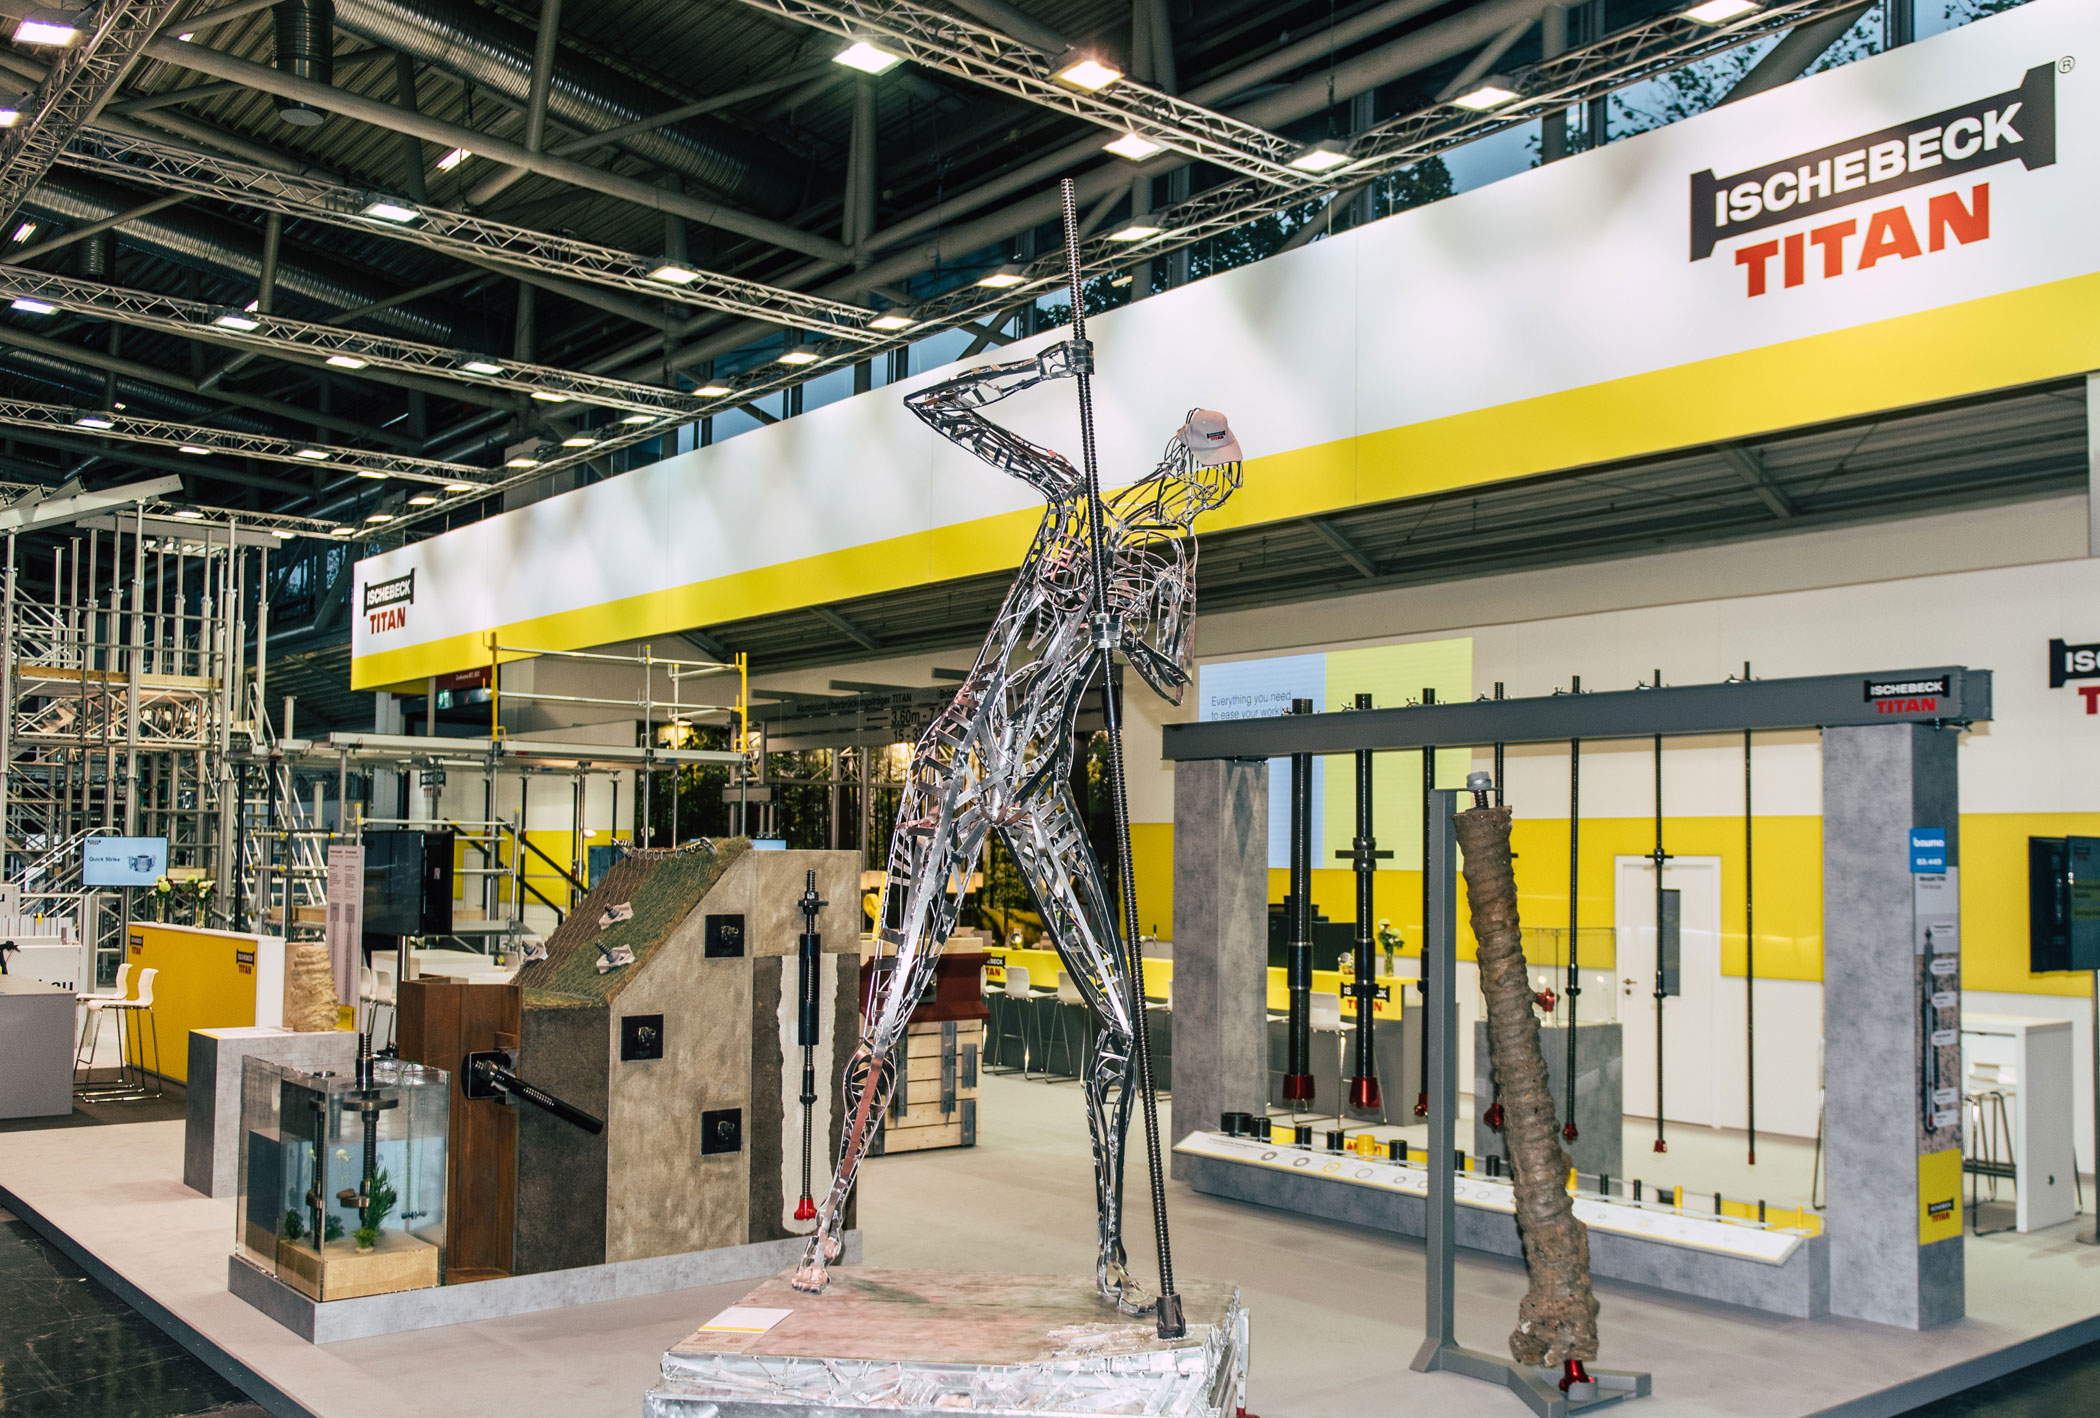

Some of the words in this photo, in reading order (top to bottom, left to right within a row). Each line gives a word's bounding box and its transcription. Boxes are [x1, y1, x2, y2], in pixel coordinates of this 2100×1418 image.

[1715, 102, 2024, 227] ISCHEBECK
[1735, 182, 1990, 298] TITAN
[367, 579, 411, 606] ISCHEBECK
[369, 606, 406, 635] TITAN
[2065, 650, 2100, 673] IS
[1870, 681, 1943, 696] ISCHEBECK
[891, 693, 912, 703] TITAN
[1211, 694, 1252, 707] Everything
[1253, 694, 1269, 706] you
[1271, 690, 1292, 702] need
[1875, 697, 1937, 714] TITAN
[891, 709, 920, 724] 3.60m
[1211, 711, 1219, 720] to
[1221, 710, 1240, 720] ease
[1241, 708, 1260, 719] your
[893, 729, 904, 742] 15
[423, 787, 442, 798] TITN
[238, 964, 252, 975] TITAN
[985, 967, 1001, 977] TAN
[1347, 999, 1383, 1012] TIN
